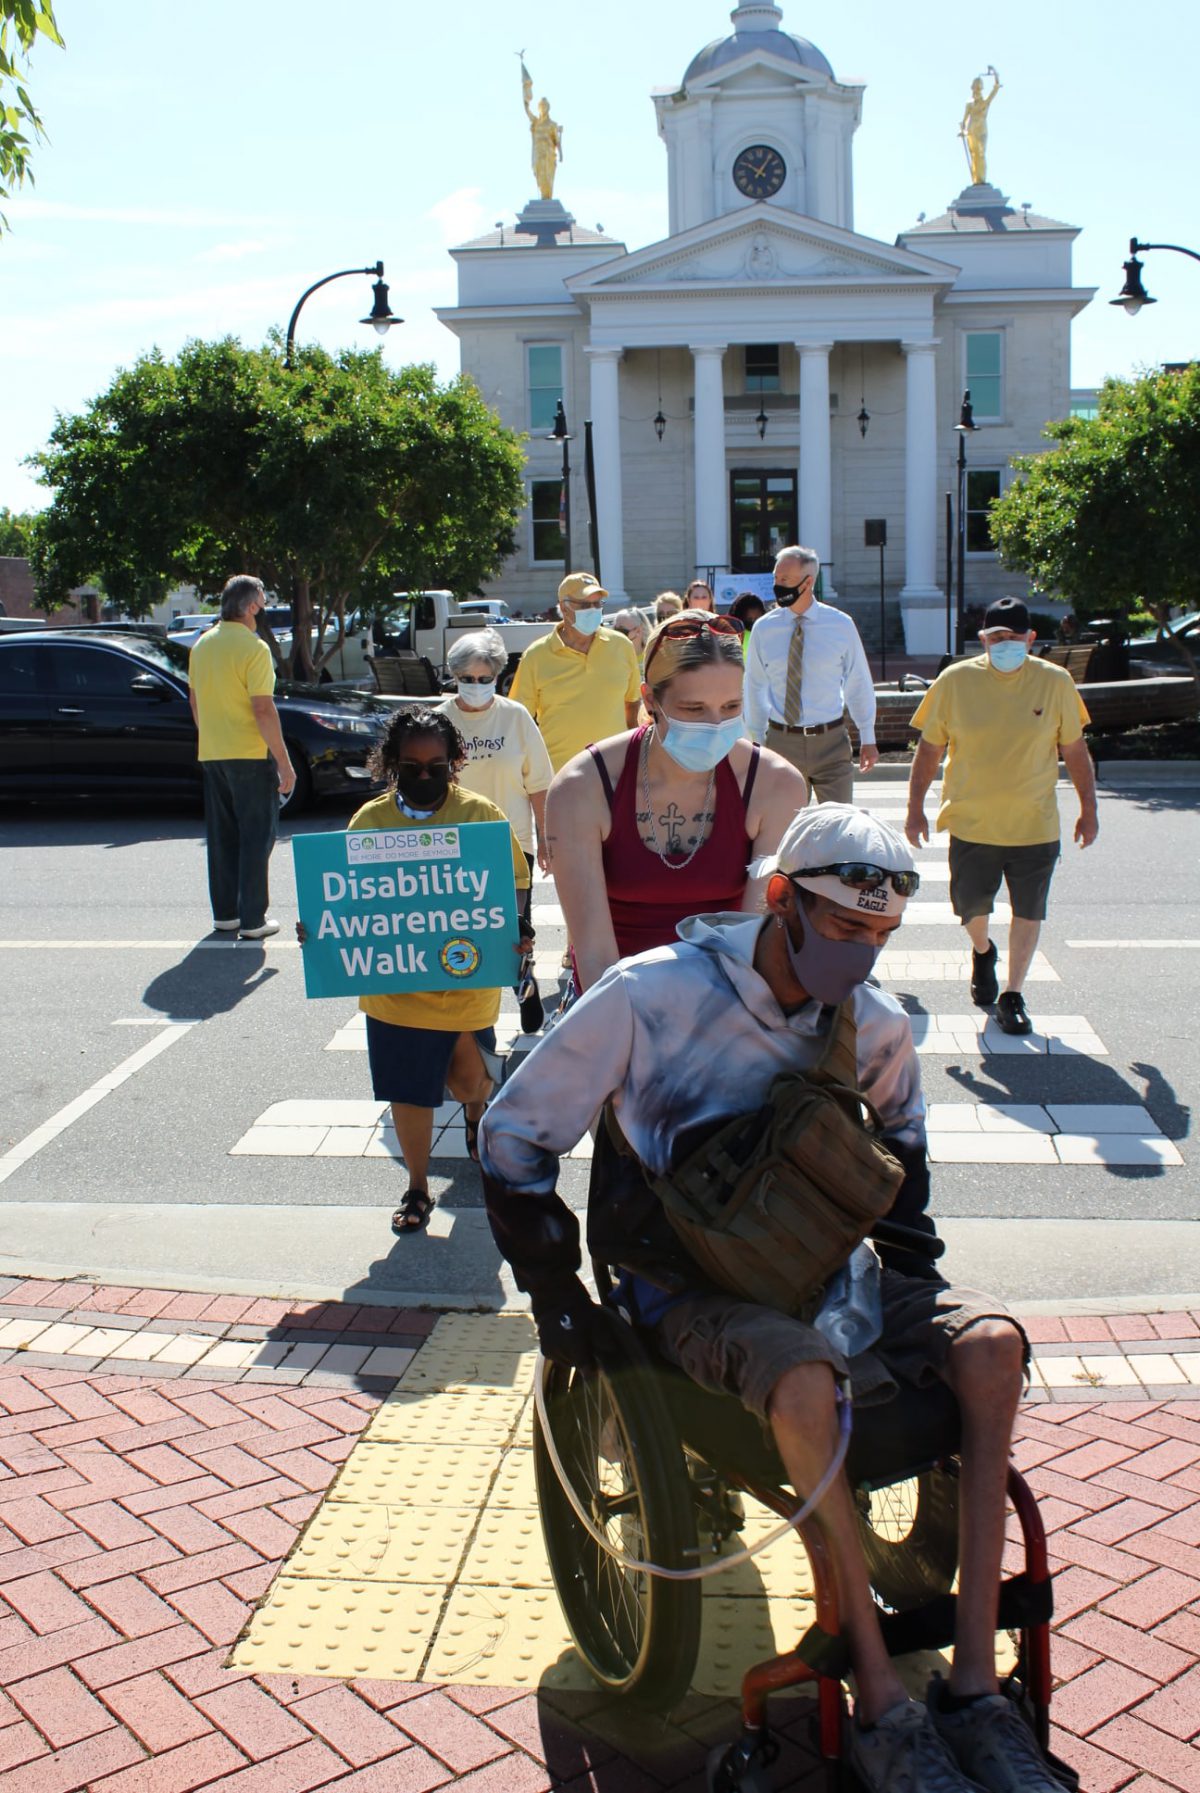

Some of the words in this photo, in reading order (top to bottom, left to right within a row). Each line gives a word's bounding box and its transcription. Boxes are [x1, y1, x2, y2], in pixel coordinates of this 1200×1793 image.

[463, 736, 505, 752] inforest
[348, 831, 457, 851] GOLDSBORO
[361, 853, 382, 861] MORE
[385, 852, 397, 860] DO
[398, 850, 420, 859] MORE
[322, 864, 490, 902] Disability
[856, 896, 887, 912] EAGLE
[317, 906, 506, 940] Awareness
[340, 943, 428, 977] Walk
